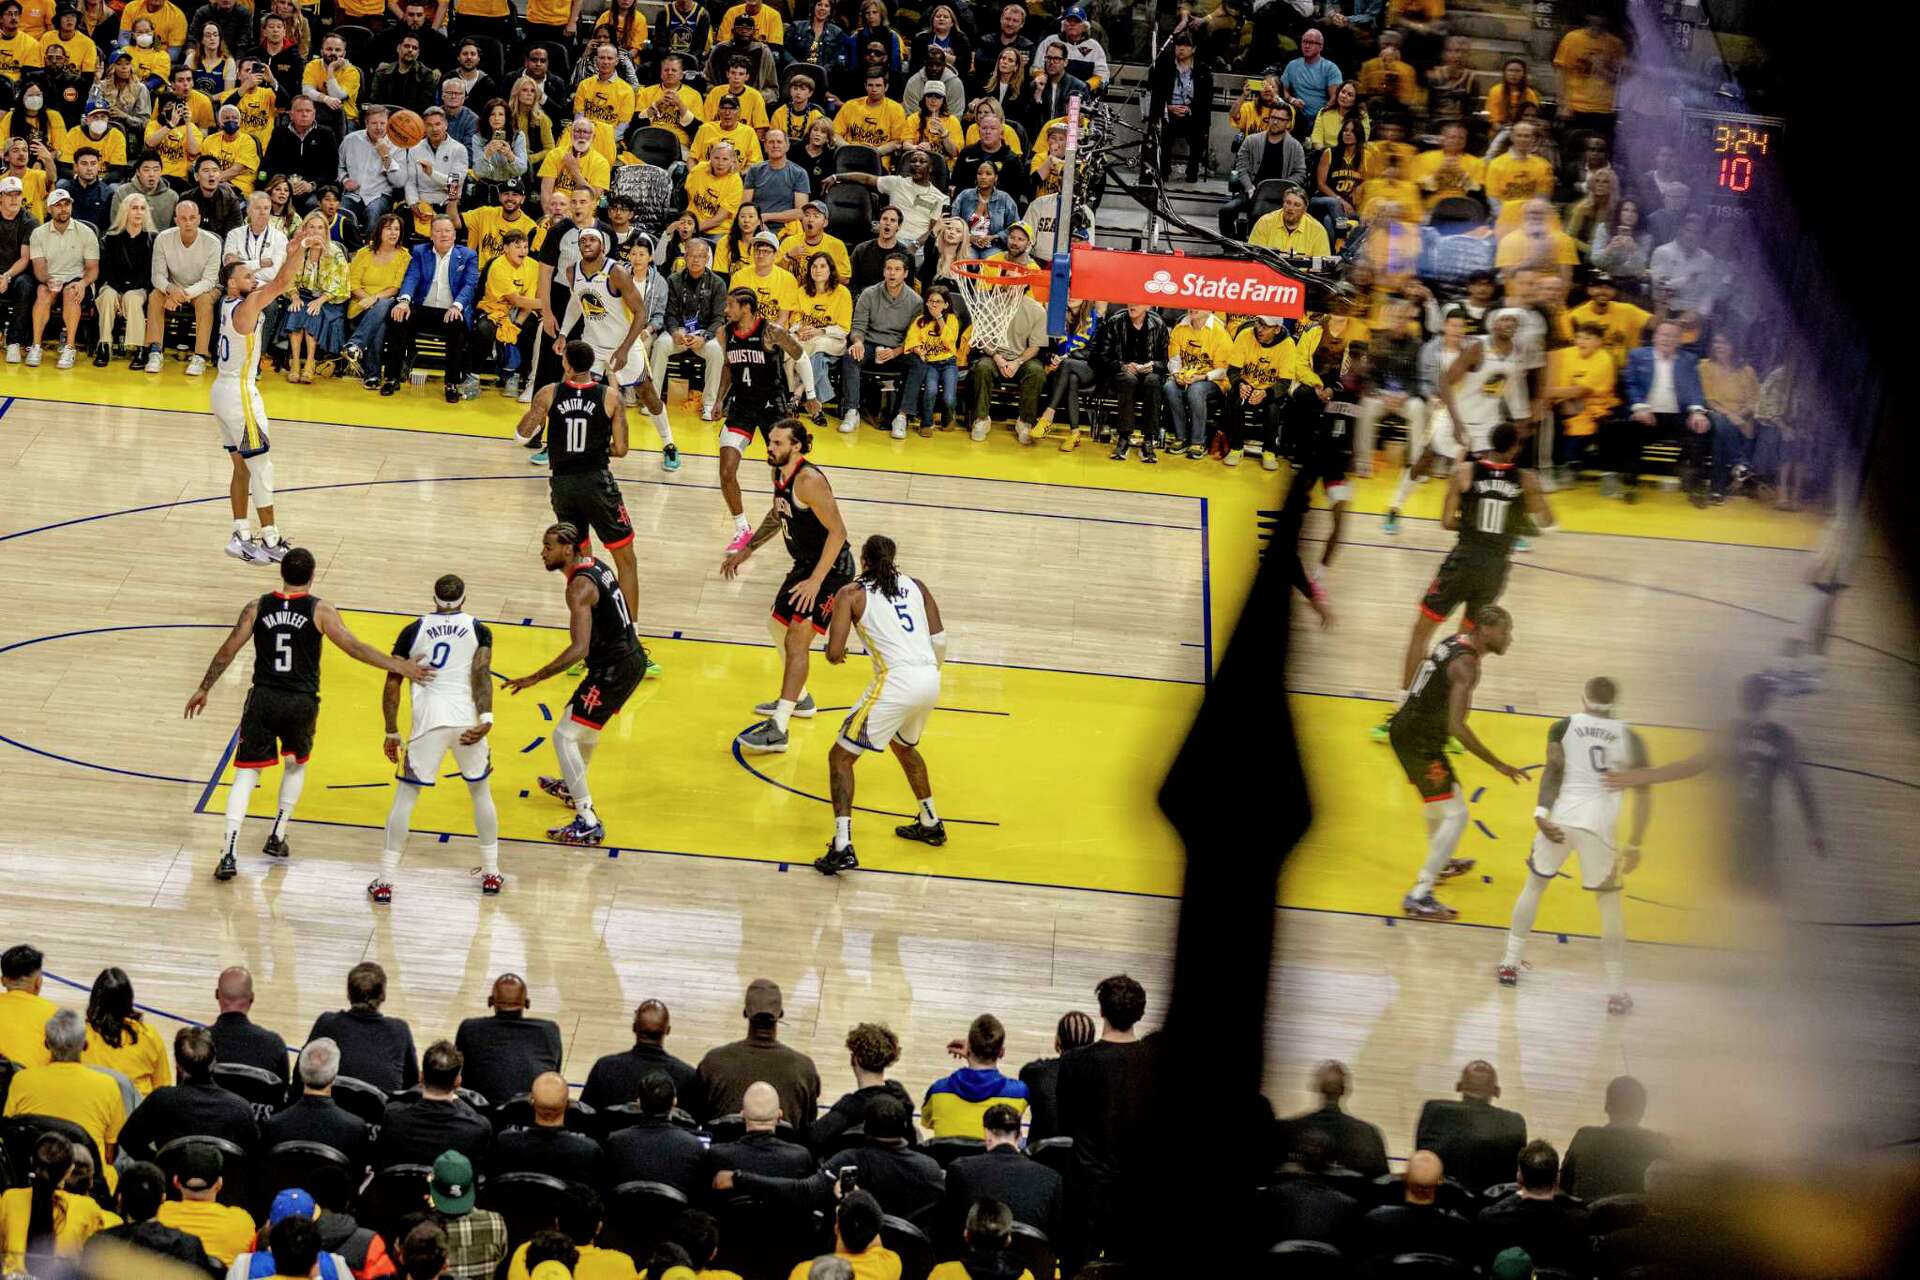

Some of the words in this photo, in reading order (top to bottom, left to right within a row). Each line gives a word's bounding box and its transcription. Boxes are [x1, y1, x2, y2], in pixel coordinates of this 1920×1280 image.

[1714, 126, 1768, 154] 3:24
[1719, 157, 1752, 192] 10
[742, 366, 753, 387] 4
[557, 398, 583, 415] SMITH
[565, 417, 588, 453] 10
[262, 610, 308, 630] VANVLEET
[894, 604, 915, 633] 5
[274, 633, 293, 672] 5
[429, 641, 451, 669] 0
